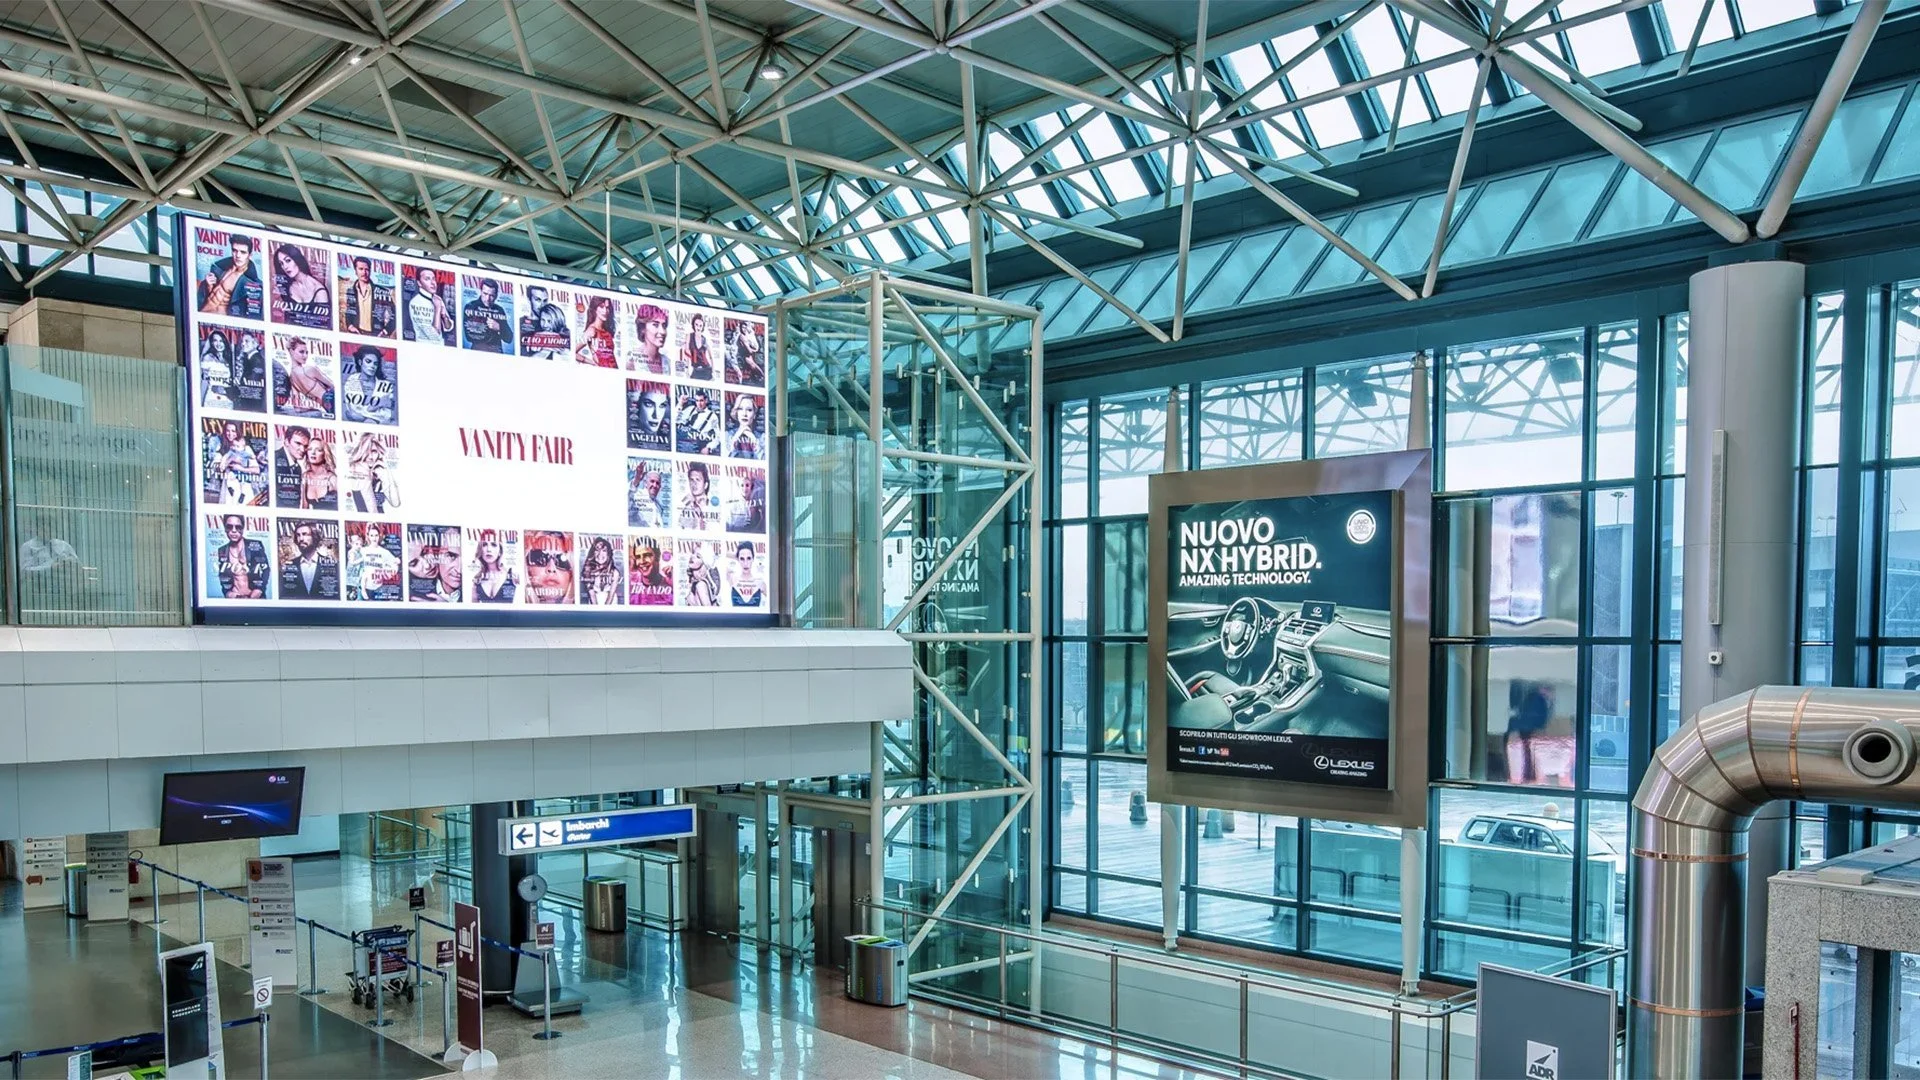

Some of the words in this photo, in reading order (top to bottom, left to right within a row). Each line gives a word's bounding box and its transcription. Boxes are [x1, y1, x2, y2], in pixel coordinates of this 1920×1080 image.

[196, 227, 231, 247] VANIT
[197, 245, 224, 257] BOLLE
[373, 258, 395, 276] FAIR
[435, 268, 456, 285] FAIR
[374, 293, 392, 302] PITT
[550, 288, 570, 304] FAIR
[272, 299, 302, 313] BOND
[310, 340, 333, 357] FAIR
[241, 376, 265, 388] Amal
[377, 381, 394, 394] RE
[345, 392, 381, 407] SOLO
[242, 421, 267, 439] FAIR
[313, 428, 336, 445] FAIR
[378, 432, 400, 449] FAIR
[459, 427, 527, 462] VANITY
[532, 434, 574, 466] FAIR
[277, 475, 300, 486] LOVE
[246, 516, 270, 532] FAIR
[316, 522, 339, 539] FAIR
[1180, 516, 1276, 547] NUOVO
[407, 531, 440, 547] VANITY
[499, 529, 518, 543] FAIR
[1180, 547, 1215, 574] NX
[1221, 542, 1323, 573] HYBRID.
[1179, 574, 1231, 587] AMAZING
[1232, 571, 1312, 586] TECHNOLOGY.
[630, 583, 673, 595] BRANDO
[1179, 729, 1206, 738] SCOPRILO
[1206, 731, 1213, 739] IN
[1213, 732, 1228, 740] TUTTI
[1238, 733, 1273, 742] SHOWROOM
[1330, 759, 1375, 771] LEXUS
[566, 818, 610, 832] Imbarchi
[1529, 1064, 1555, 1080] ADR
